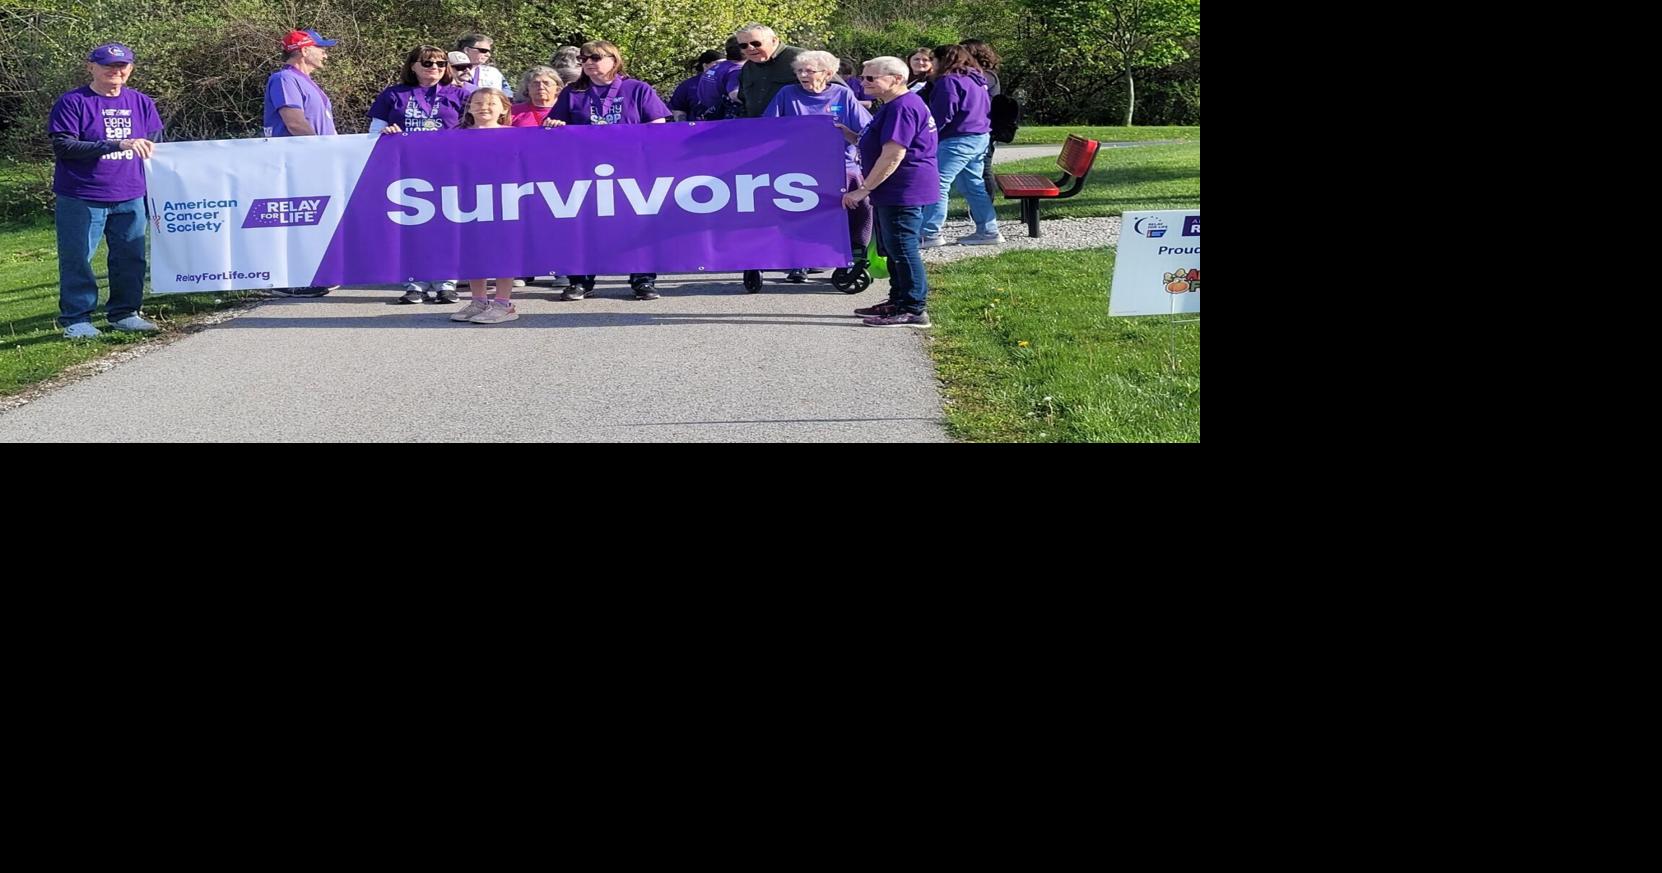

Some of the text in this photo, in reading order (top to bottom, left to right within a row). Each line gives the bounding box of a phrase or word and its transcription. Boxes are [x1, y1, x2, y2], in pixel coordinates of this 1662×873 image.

[386, 164, 820, 226] Survivors
[163, 198, 238, 211] American
[267, 200, 321, 212] RELAY
[164, 210, 219, 222] Cancer
[279, 211, 315, 224] LIFE
[167, 221, 222, 233] Society
[175, 270, 271, 283] RelayForLife.org
